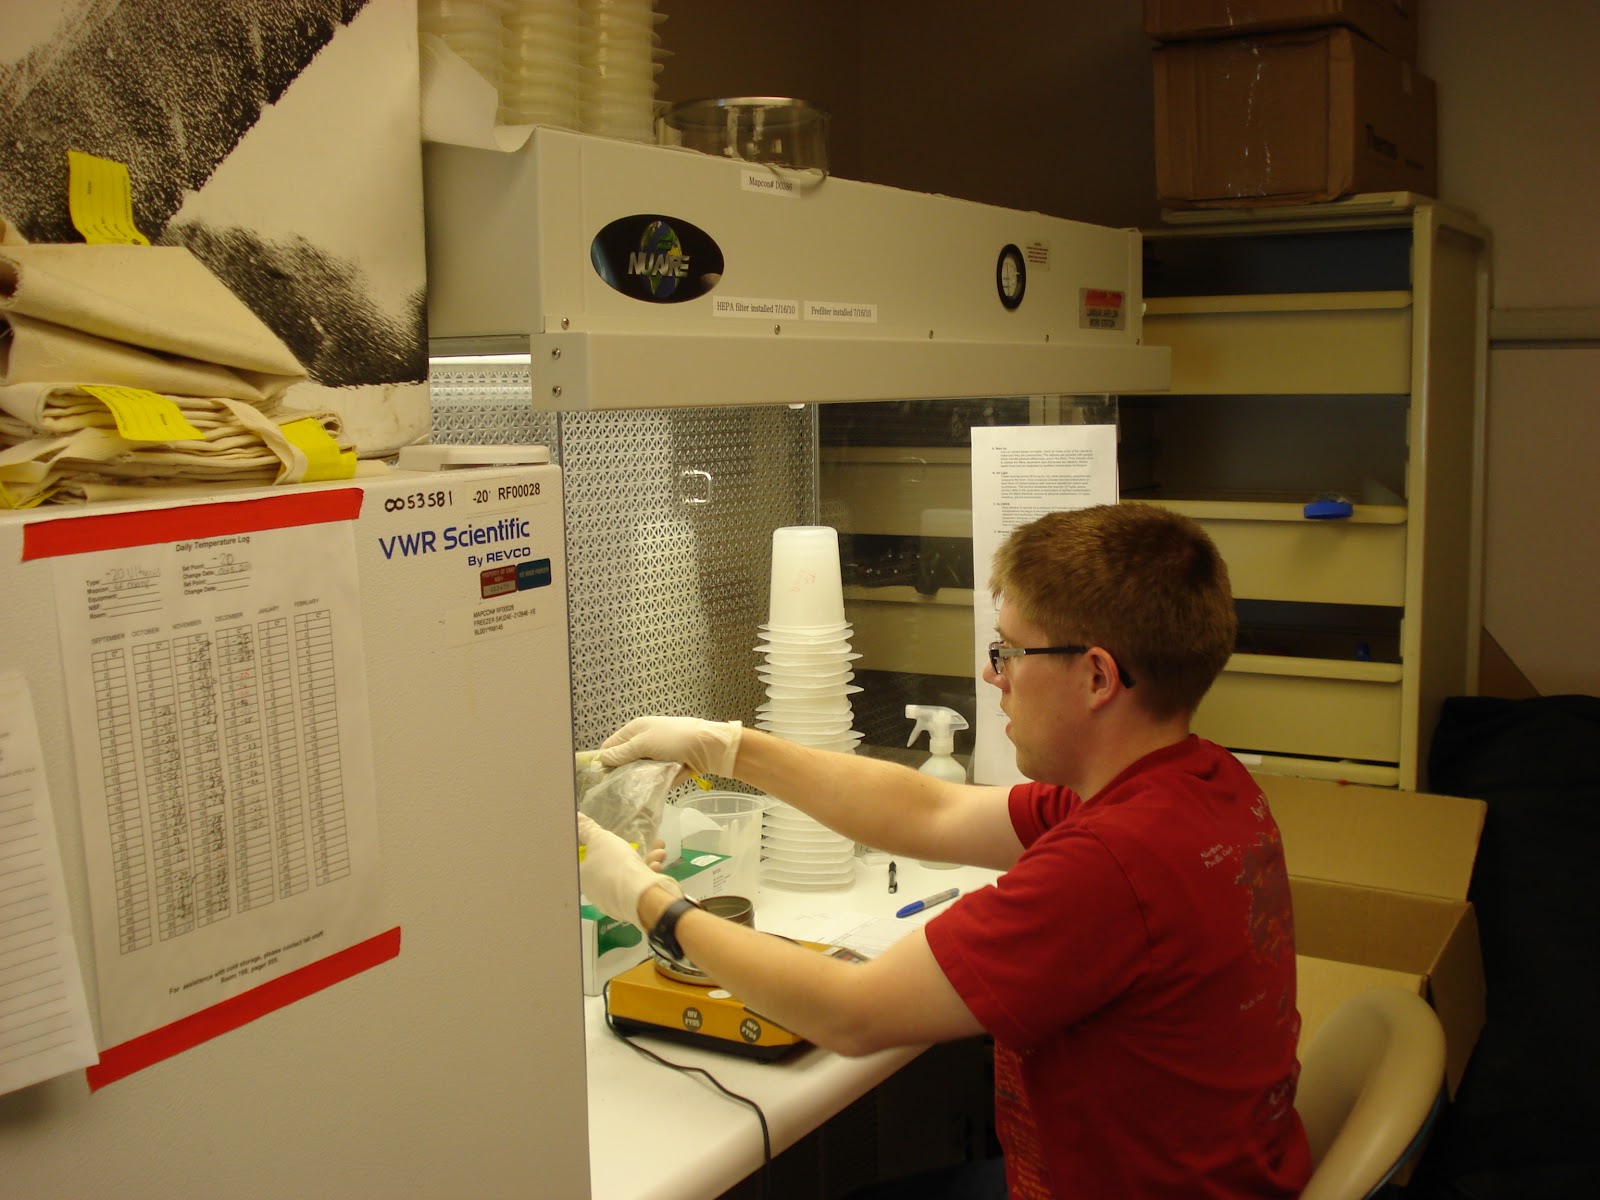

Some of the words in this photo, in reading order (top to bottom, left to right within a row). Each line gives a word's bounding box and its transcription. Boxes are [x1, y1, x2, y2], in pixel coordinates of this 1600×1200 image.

[749, 176, 774, 190] Mapcon#
[717, 301, 734, 311] HEPA
[735, 302, 749, 313] filter
[750, 303, 774, 314] installed
[774, 304, 796, 315] 7/16/10
[811, 306, 831, 317] Prefilter
[831, 307, 853, 317] installed
[853, 307, 872, 318] 7/16/10
[498, 483, 541, 501] RF00028
[175, 542, 192, 552] Daily
[194, 537, 236, 550] Temperature
[237, 535, 250, 544] Log
[378, 531, 437, 560] VWR
[443, 518, 530, 551] Scientific
[468, 556, 483, 567] By
[486, 547, 531, 563] REVCO
[215, 612, 243, 622] DECEMBER
[132, 627, 160, 637] OCTOBER
[172, 620, 202, 630] NOVEMBER
[91, 633, 125, 645] SEPTEMBER
[169, 987, 180, 995] For
[182, 974, 214, 990] assistance
[214, 968, 225, 978] with
[226, 963, 240, 974] cold
[263, 948, 282, 960] please
[282, 940, 303, 953] contact
[220, 973, 238, 984] Room
[251, 962, 267, 974] pager
[687, 1010, 698, 1018] INV
[746, 1020, 759, 1032] INV
